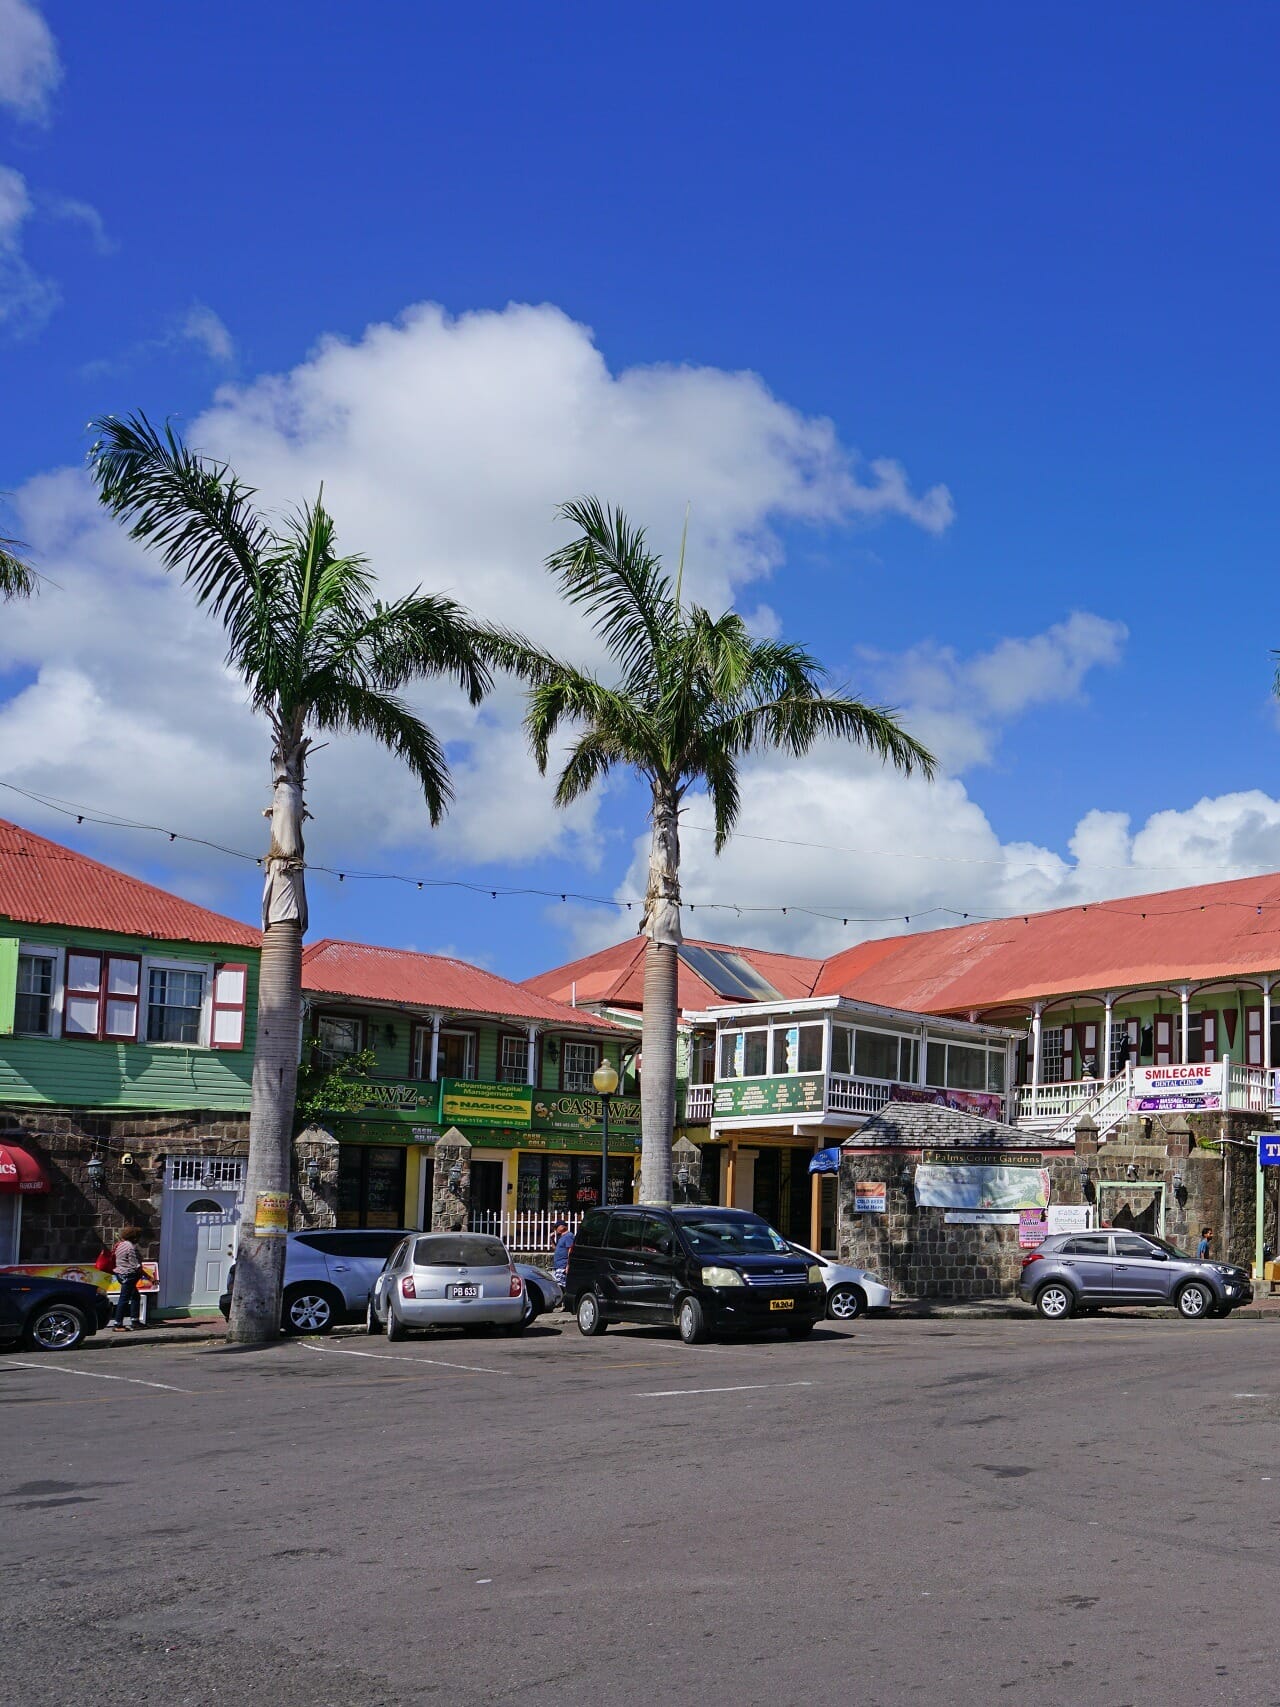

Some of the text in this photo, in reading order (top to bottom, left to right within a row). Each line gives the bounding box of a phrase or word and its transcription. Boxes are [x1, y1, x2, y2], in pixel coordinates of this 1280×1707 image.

[1145, 1067, 1212, 1080] SMILECARE
[454, 1082, 523, 1093] Advantage Capital
[1155, 1079, 1199, 1088] DENTAL CLINIC
[464, 1088, 514, 1098] Management
[460, 1101, 514, 1111] NAGICO
[935, 1154, 1040, 1163] Palms Court Gardens
[464, 1287, 477, 1296] 633
